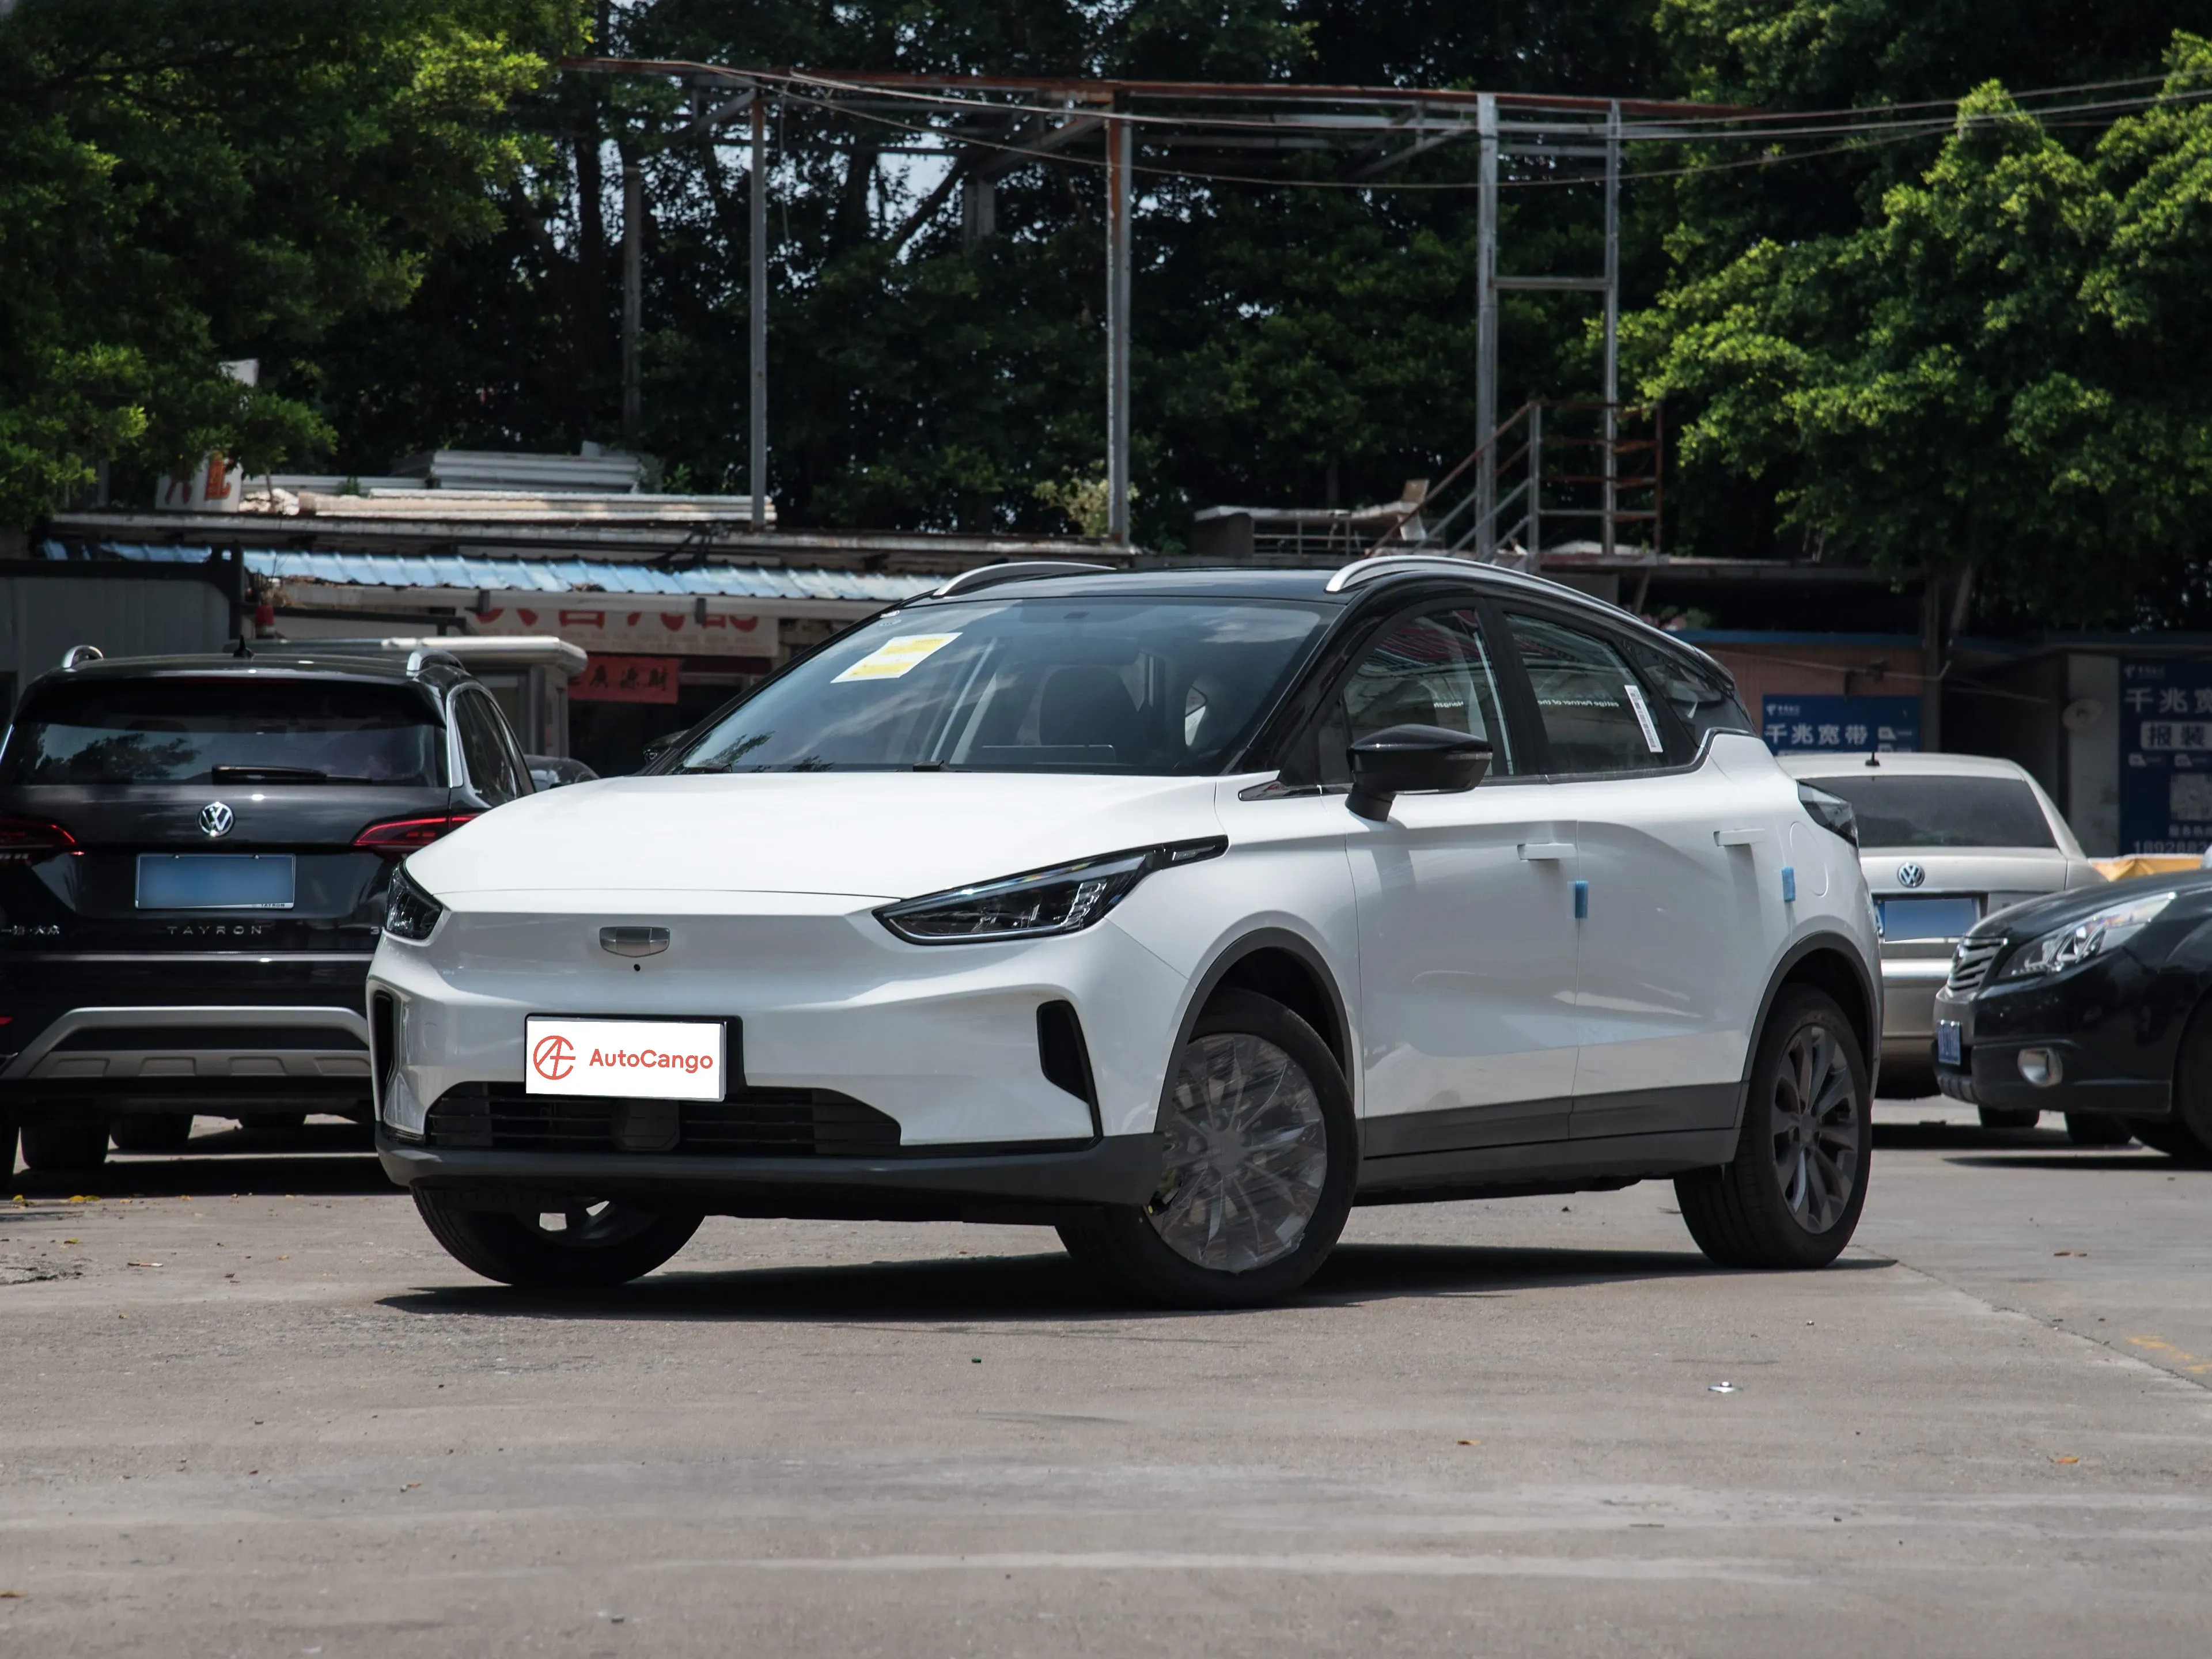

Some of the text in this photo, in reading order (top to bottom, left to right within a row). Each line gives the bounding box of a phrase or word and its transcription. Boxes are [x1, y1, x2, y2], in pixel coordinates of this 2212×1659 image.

[1764, 722, 1868, 745] 千兆宽带
[167, 926, 262, 935] TAYRON
